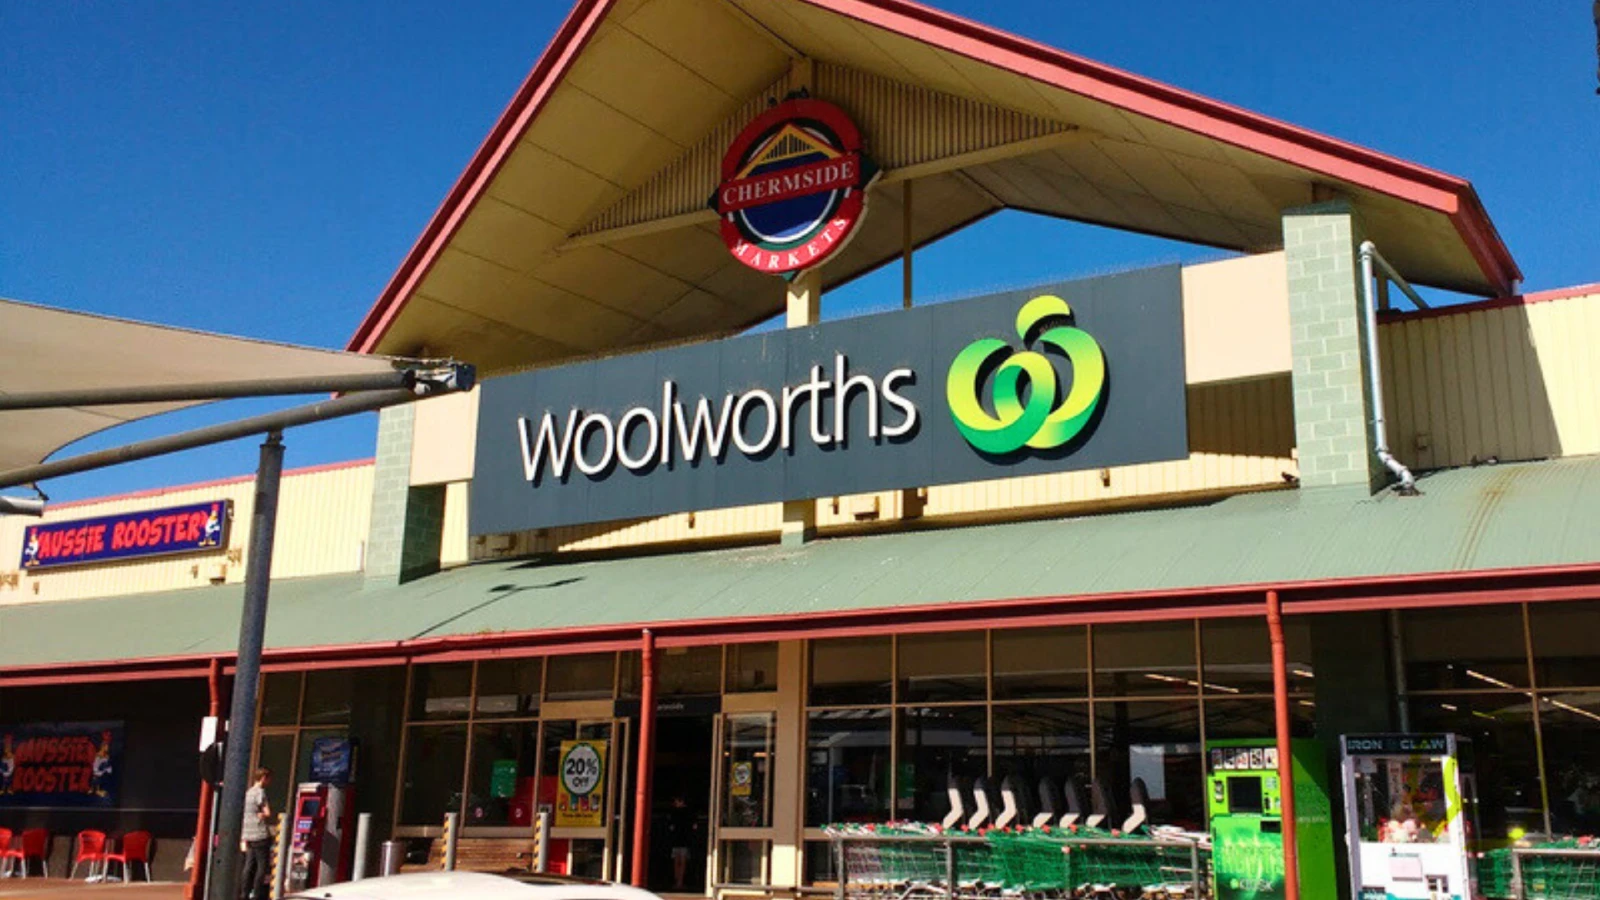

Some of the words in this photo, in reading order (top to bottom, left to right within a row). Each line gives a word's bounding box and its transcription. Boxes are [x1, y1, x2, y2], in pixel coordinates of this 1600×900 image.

[723, 161, 854, 205] CHERMSIDE
[734, 217, 847, 269] MARKETS
[517, 353, 918, 482] Woolworths
[37, 524, 107, 559] AUSSIE
[111, 512, 202, 550] ROOSTER
[15, 735, 92, 763] AUSSIE
[1347, 739, 1383, 750] IRON
[1399, 739, 1445, 750] CLAW
[12, 765, 92, 793] ROOSTER
[566, 757, 598, 776] 20%
